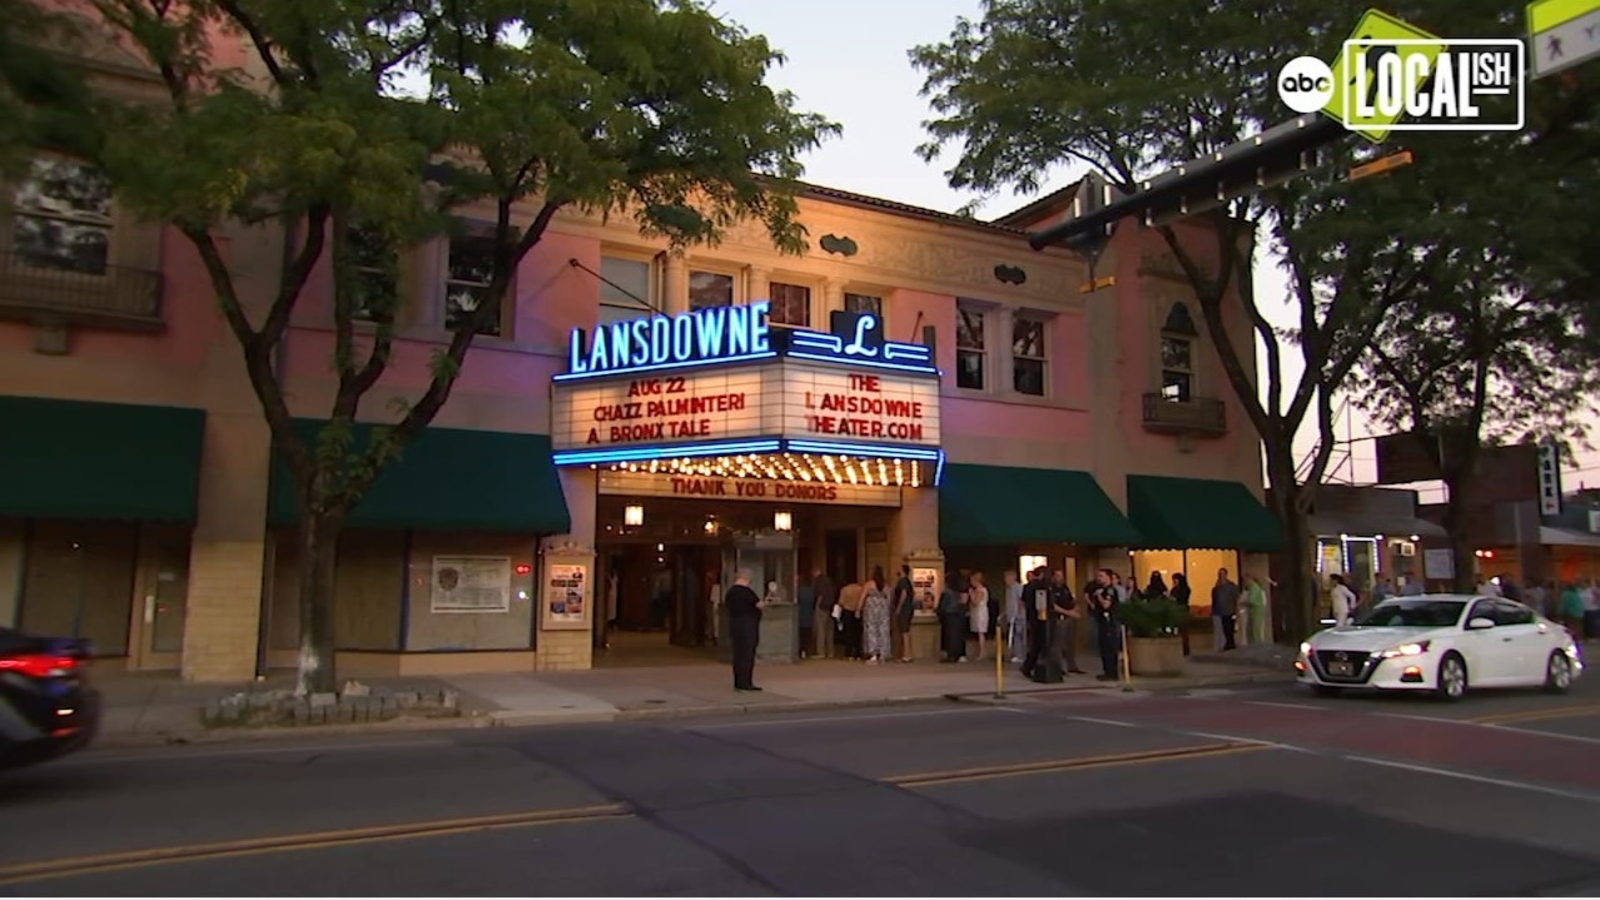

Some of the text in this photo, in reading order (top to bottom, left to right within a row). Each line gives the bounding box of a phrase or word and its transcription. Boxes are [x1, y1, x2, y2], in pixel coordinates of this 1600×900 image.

[570, 302, 769, 373] LANSDOWNE
[844, 315, 877, 357] L
[628, 377, 685, 398] AUG 22
[848, 373, 880, 392] THE
[594, 393, 745, 422] CHAZZ PALMINTERI
[586, 419, 710, 444] A BRONX TALE
[804, 414, 923, 441] THEATER.COM
[670, 477, 837, 500] THANK YOU DONORS
